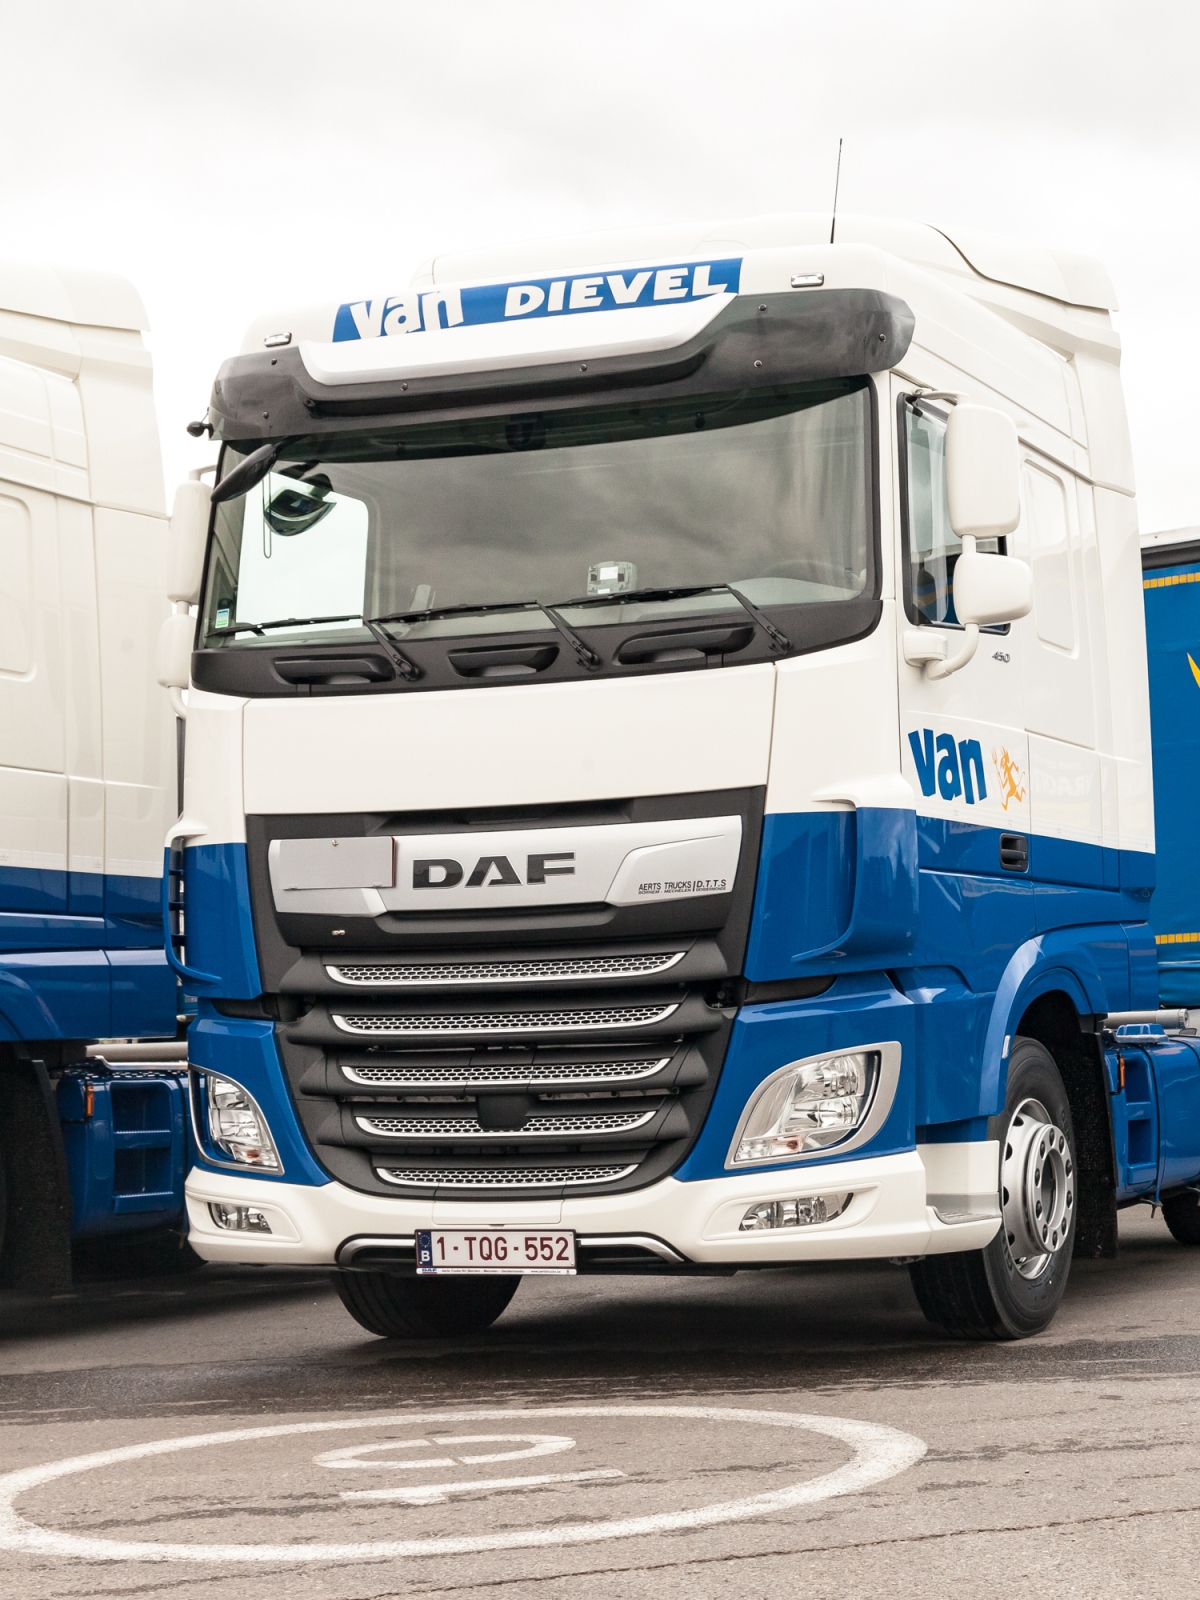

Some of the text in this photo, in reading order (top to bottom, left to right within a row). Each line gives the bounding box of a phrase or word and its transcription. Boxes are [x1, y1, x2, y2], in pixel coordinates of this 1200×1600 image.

[504, 265, 728, 317] DIEVEL
[412, 851, 577, 889] DAF
[638, 880, 692, 890] AERTS TRUCKS
[696, 879, 726, 887] D.T.T.S
[421, 1251, 430, 1262] B
